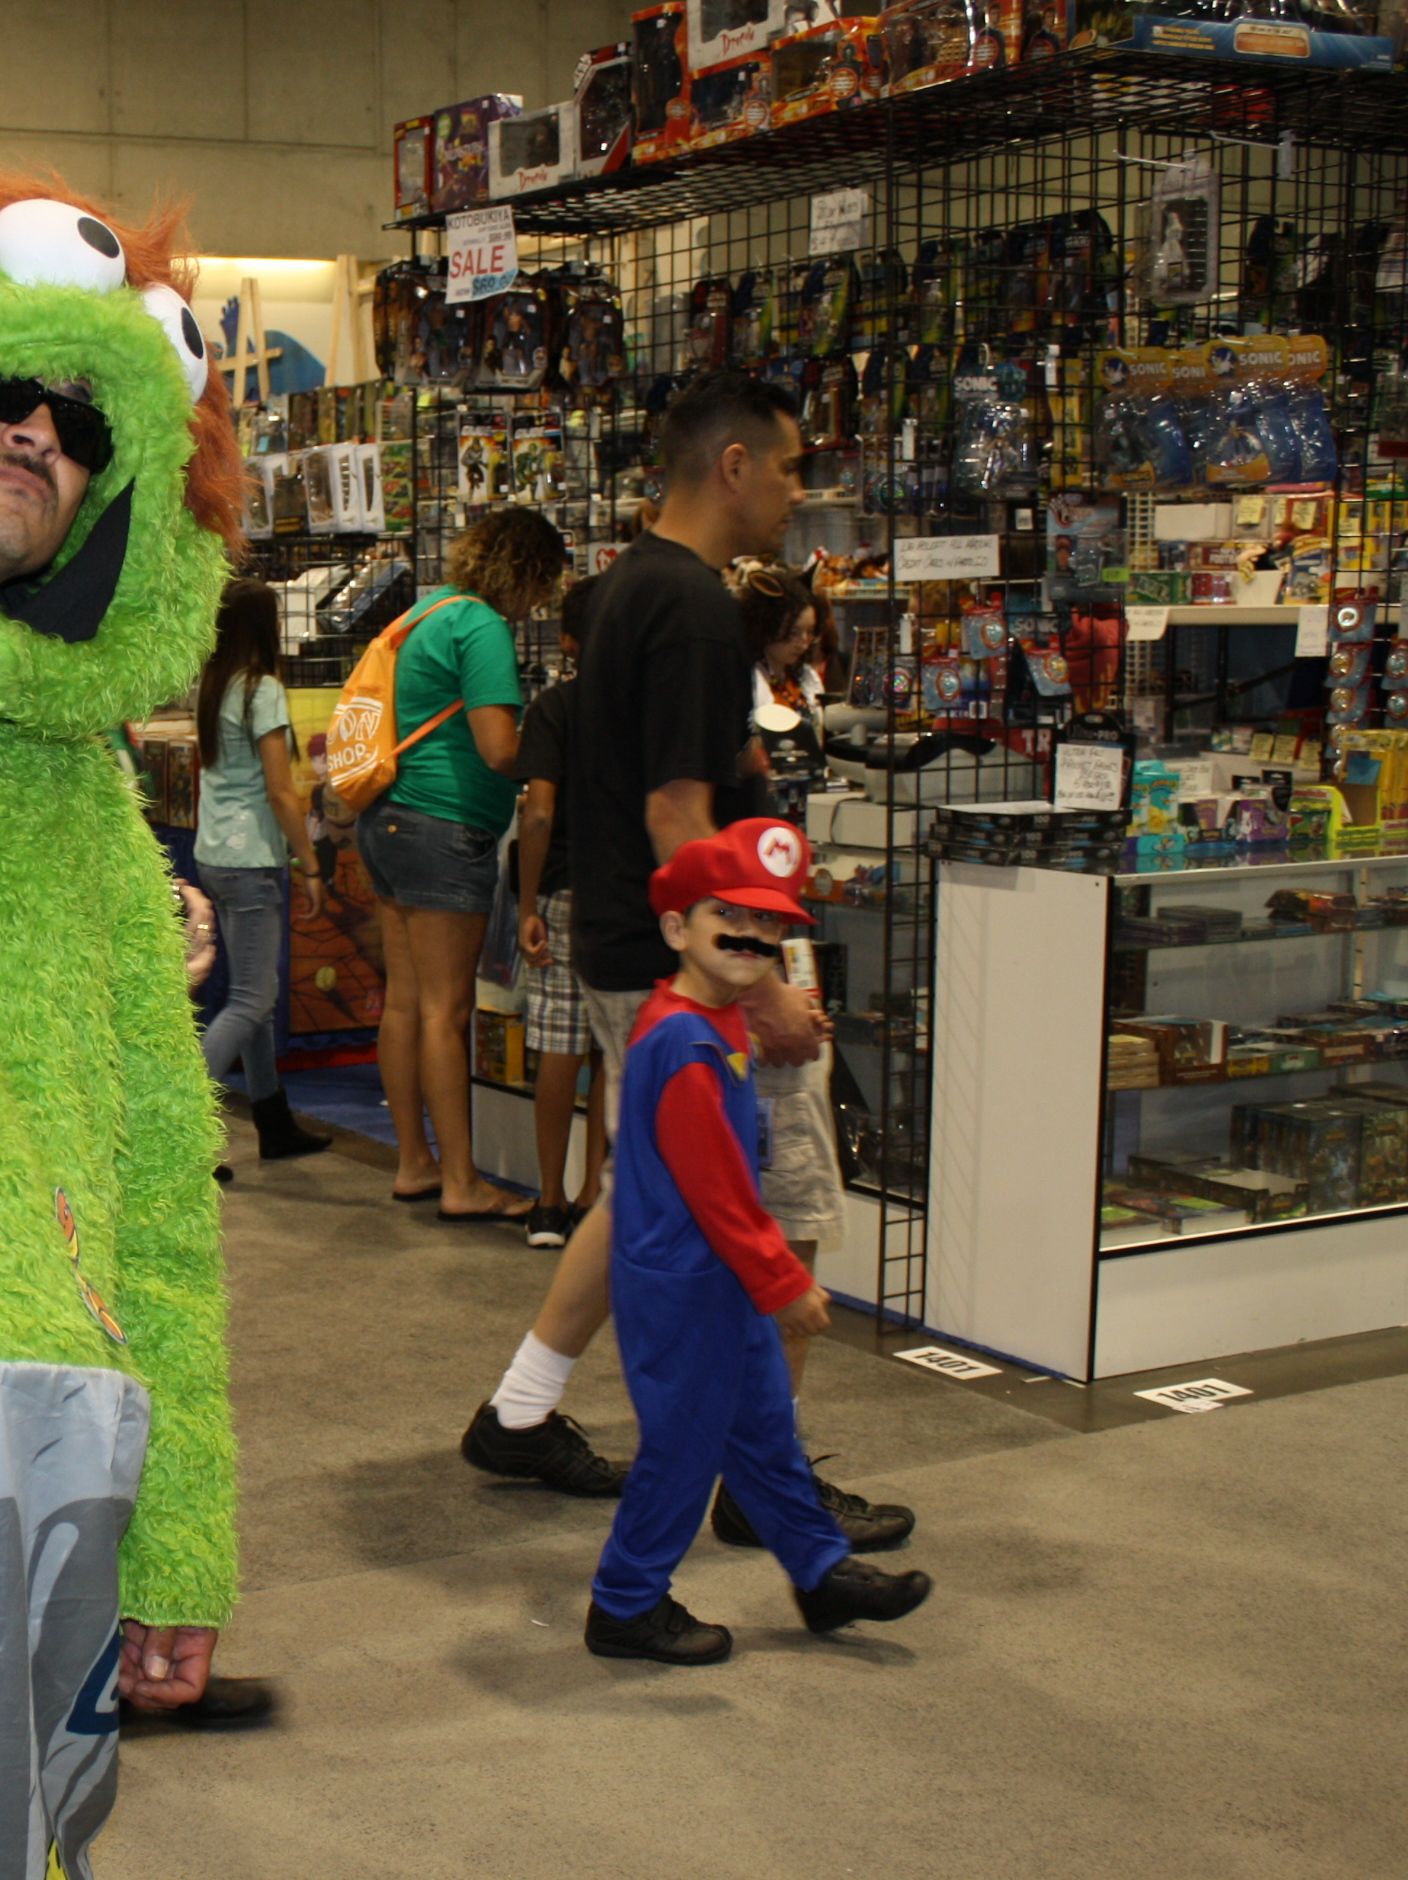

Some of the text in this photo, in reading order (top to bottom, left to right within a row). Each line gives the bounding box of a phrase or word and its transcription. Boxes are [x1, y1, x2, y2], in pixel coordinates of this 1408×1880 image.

[447, 208, 511, 230] KOTOBUKIYA
[449, 244, 505, 279] SALE
[1239, 350, 1283, 366] SONIC
[1288, 350, 1321, 366] ONIC
[1128, 361, 1167, 376] SONIC
[1172, 366, 1205, 379] SONI
[913, 1352, 980, 1373] 1401
[1156, 1384, 1230, 1402] 1401
